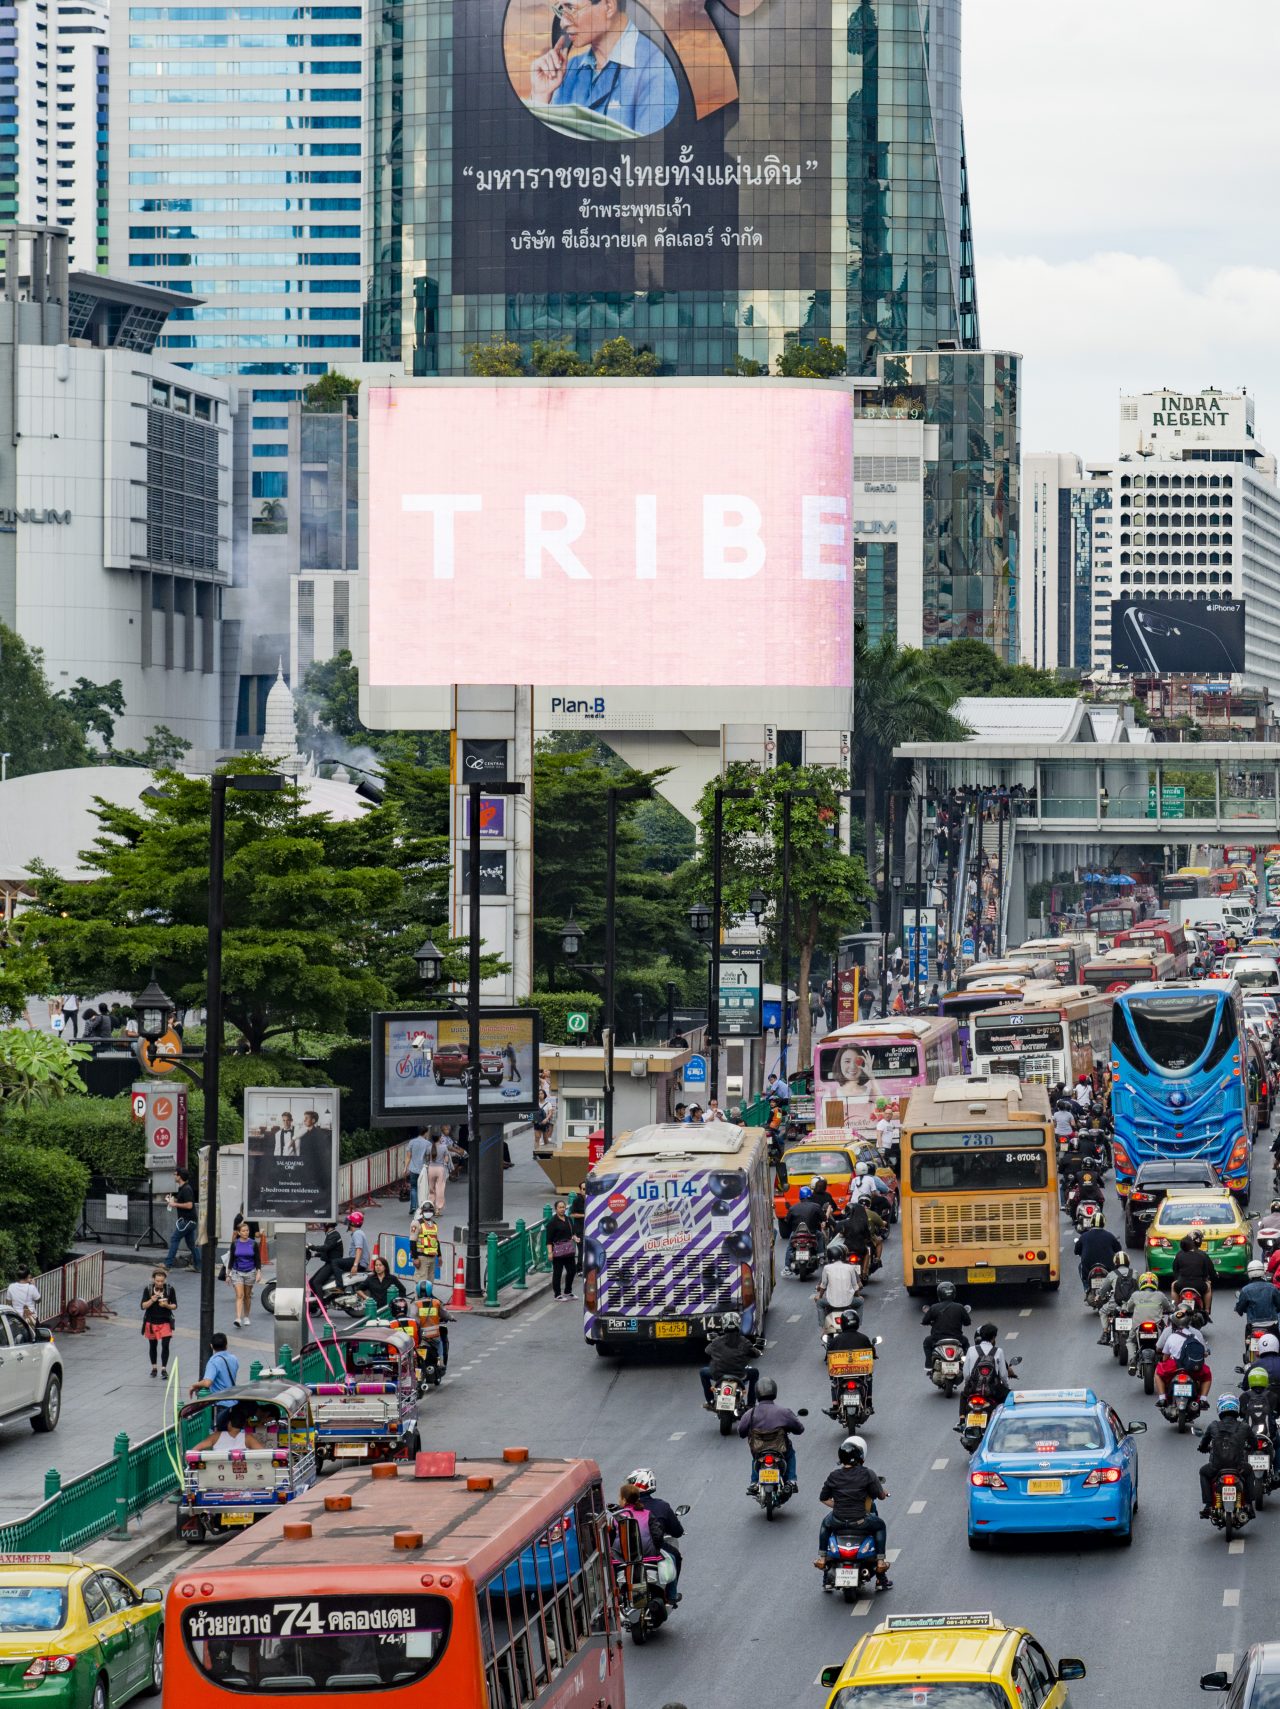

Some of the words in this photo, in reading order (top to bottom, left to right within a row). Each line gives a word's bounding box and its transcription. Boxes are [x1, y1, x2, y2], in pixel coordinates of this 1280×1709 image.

[462, 145, 819, 191] “มหาราชของไทยทั้งแผ่นดิน”
[579, 197, 692, 224] ข้าพระพุทธเจ้า
[510, 230, 556, 250] บริษัท
[561, 227, 648, 249] ซีเอ็มวายเค
[654, 226, 714, 248] คัลเลอร์
[720, 226, 763, 248] จำกัด
[1161, 397, 1221, 412] INDRA
[1153, 412, 1230, 427] REGENT
[401, 493, 848, 582] TRIBE
[1011, 1015, 1024, 1024] 73
[138, 1100, 143, 1113] P
[1006, 1154, 1041, 1163] 8-67054
[672, 1181, 697, 1198] 14
[658, 1324, 685, 1333] 15-4754
[188, 1610, 271, 1637] ห้วยขวาง
[272, 1603, 326, 1636] 74
[327, 1604, 416, 1631] คลองเตย
